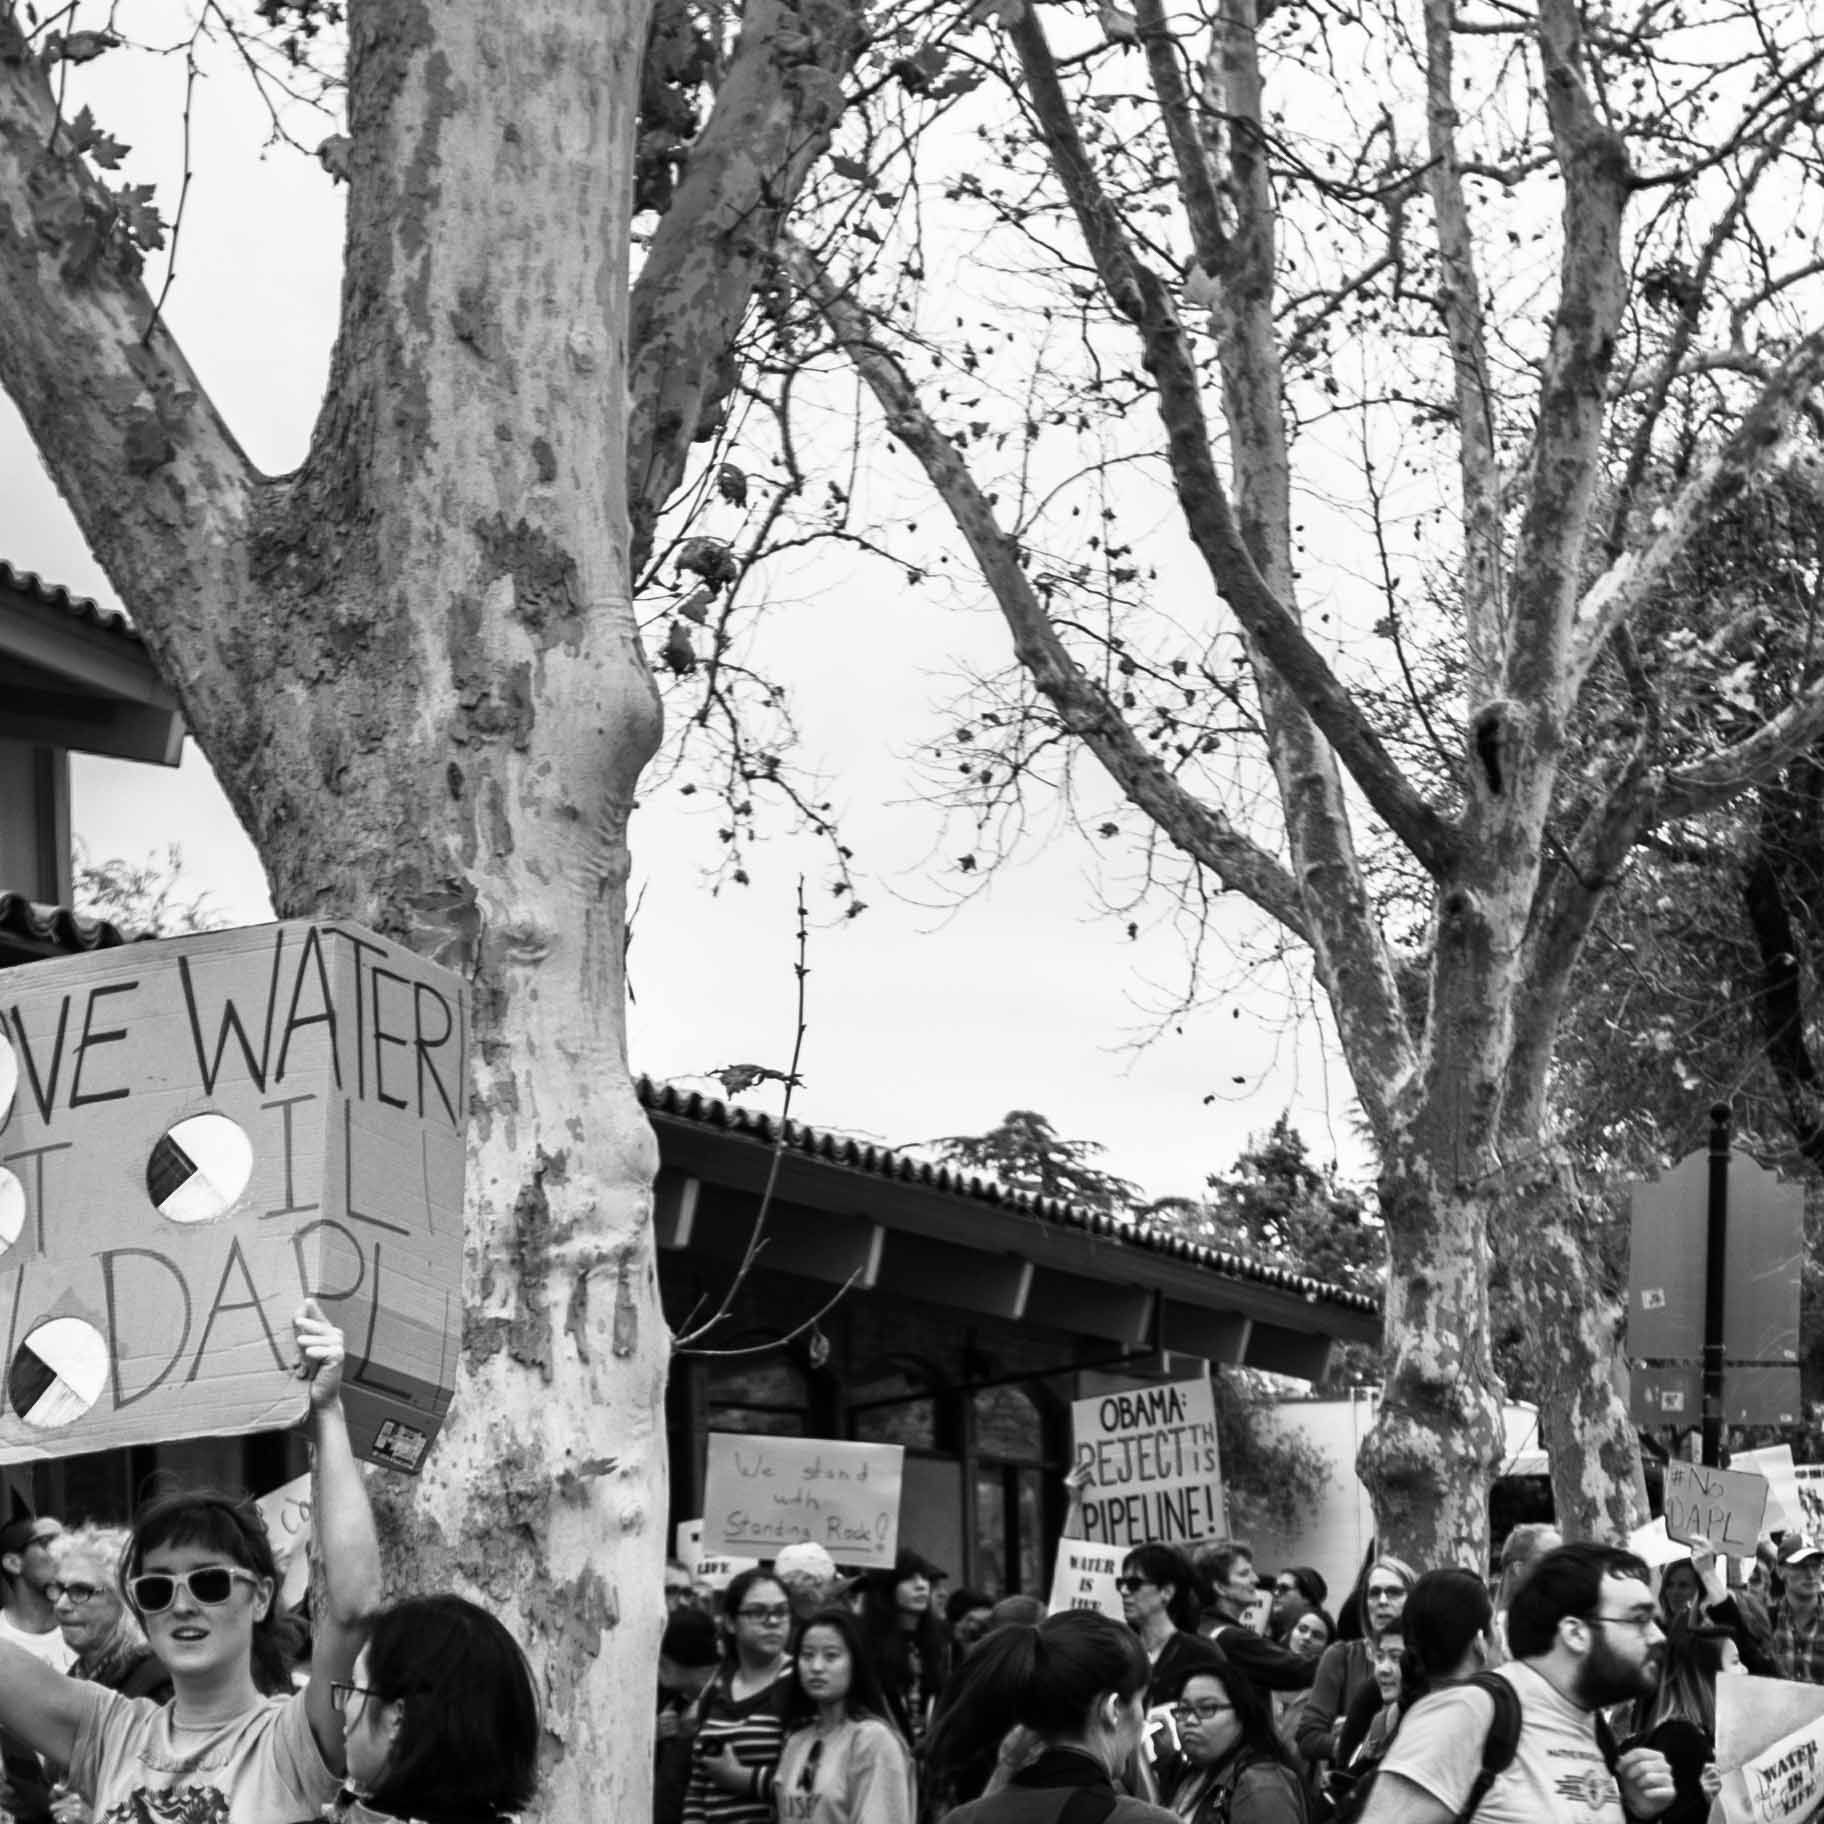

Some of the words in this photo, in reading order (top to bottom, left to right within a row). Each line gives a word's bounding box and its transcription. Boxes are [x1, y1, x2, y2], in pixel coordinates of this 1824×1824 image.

[734, 1451, 776, 1478] We
[801, 1456, 868, 1481] stand
[723, 1510, 811, 1540] Standing
[1081, 1485, 1216, 1547] PIPELINE!
[1667, 1495, 1745, 1546] DAPL
[1069, 1555, 1115, 1575] WATER
[1080, 1577, 1094, 1593] IS
